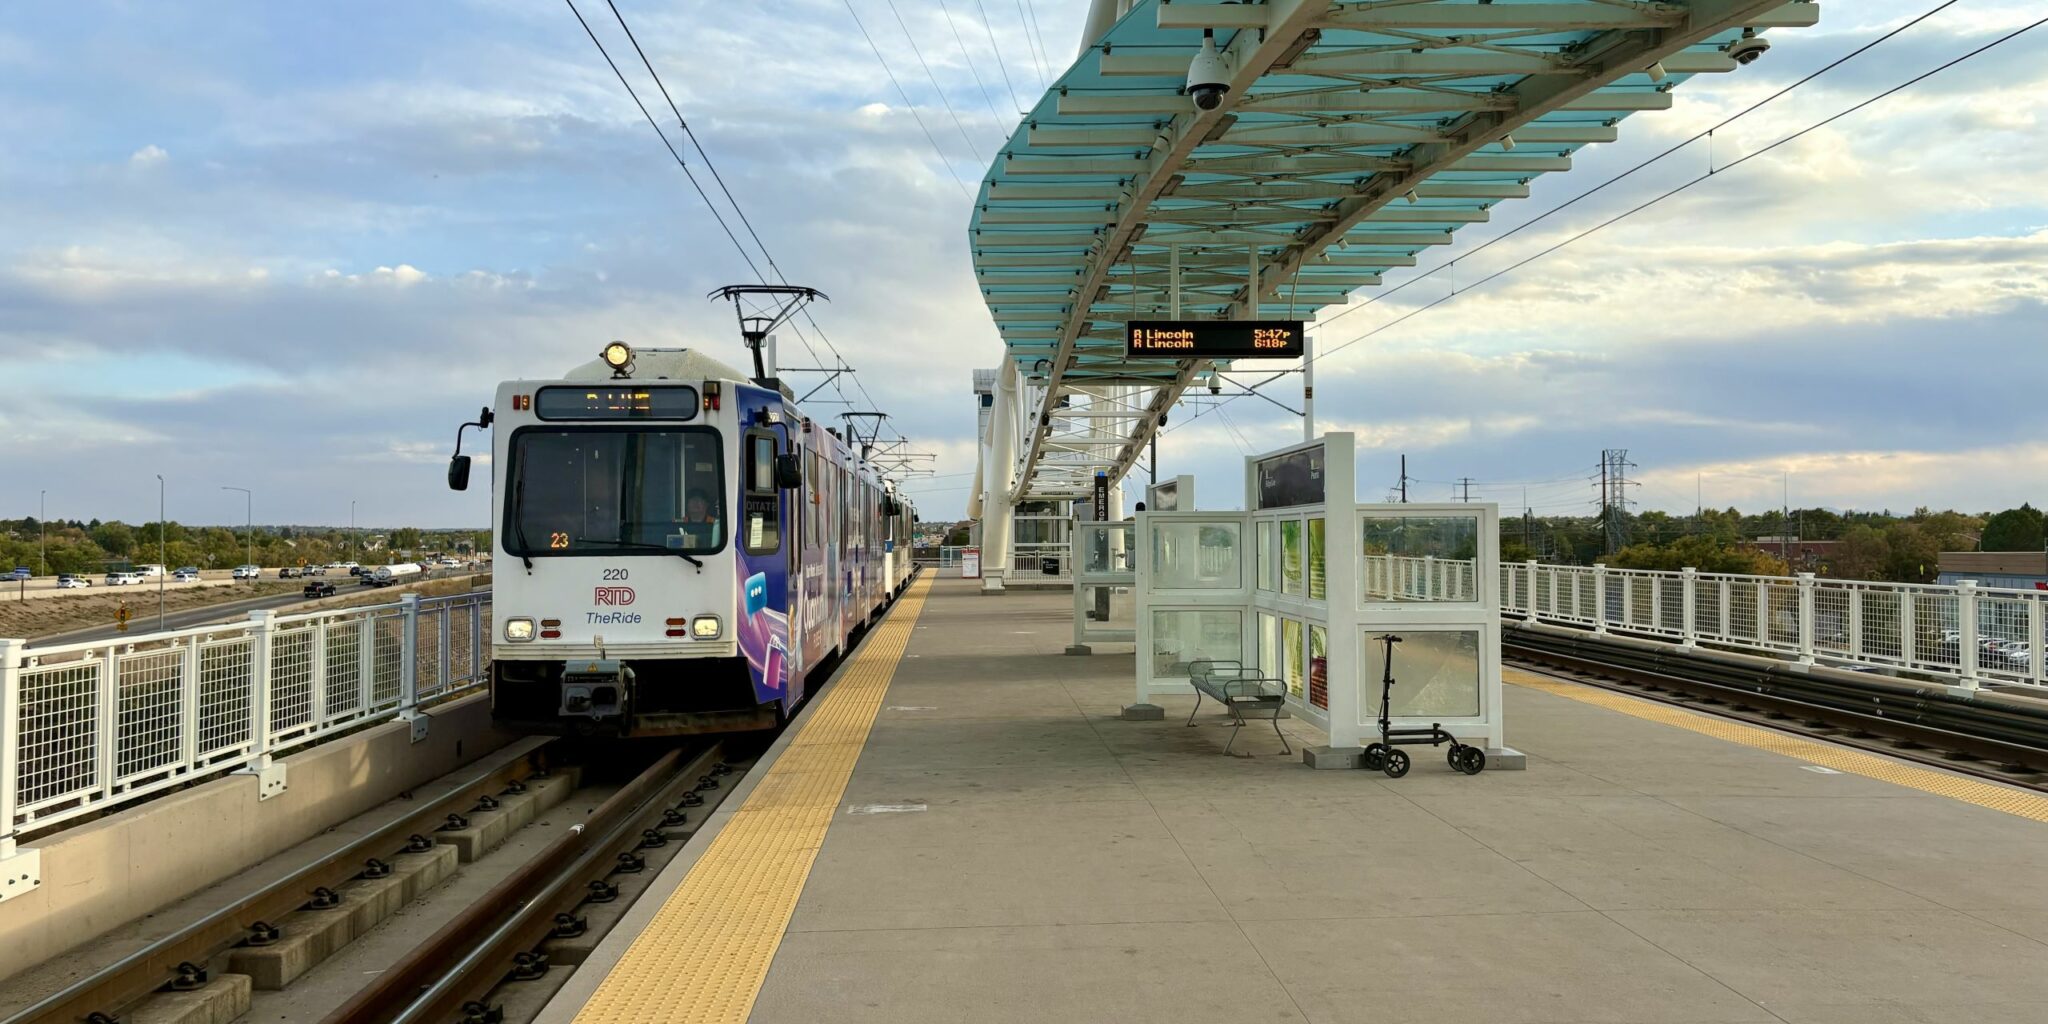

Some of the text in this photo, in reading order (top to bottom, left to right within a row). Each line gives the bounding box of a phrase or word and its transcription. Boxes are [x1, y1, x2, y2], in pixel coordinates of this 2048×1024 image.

[1134, 329, 1142, 339] R
[1146, 329, 1194, 339] Lincoln
[1134, 339, 1142, 348] R
[1146, 339, 1194, 348] Lincoln
[551, 532, 569, 549] 23
[602, 568, 629, 581] 220
[594, 586, 636, 606] RTD
[586, 611, 642, 624] TheRide
